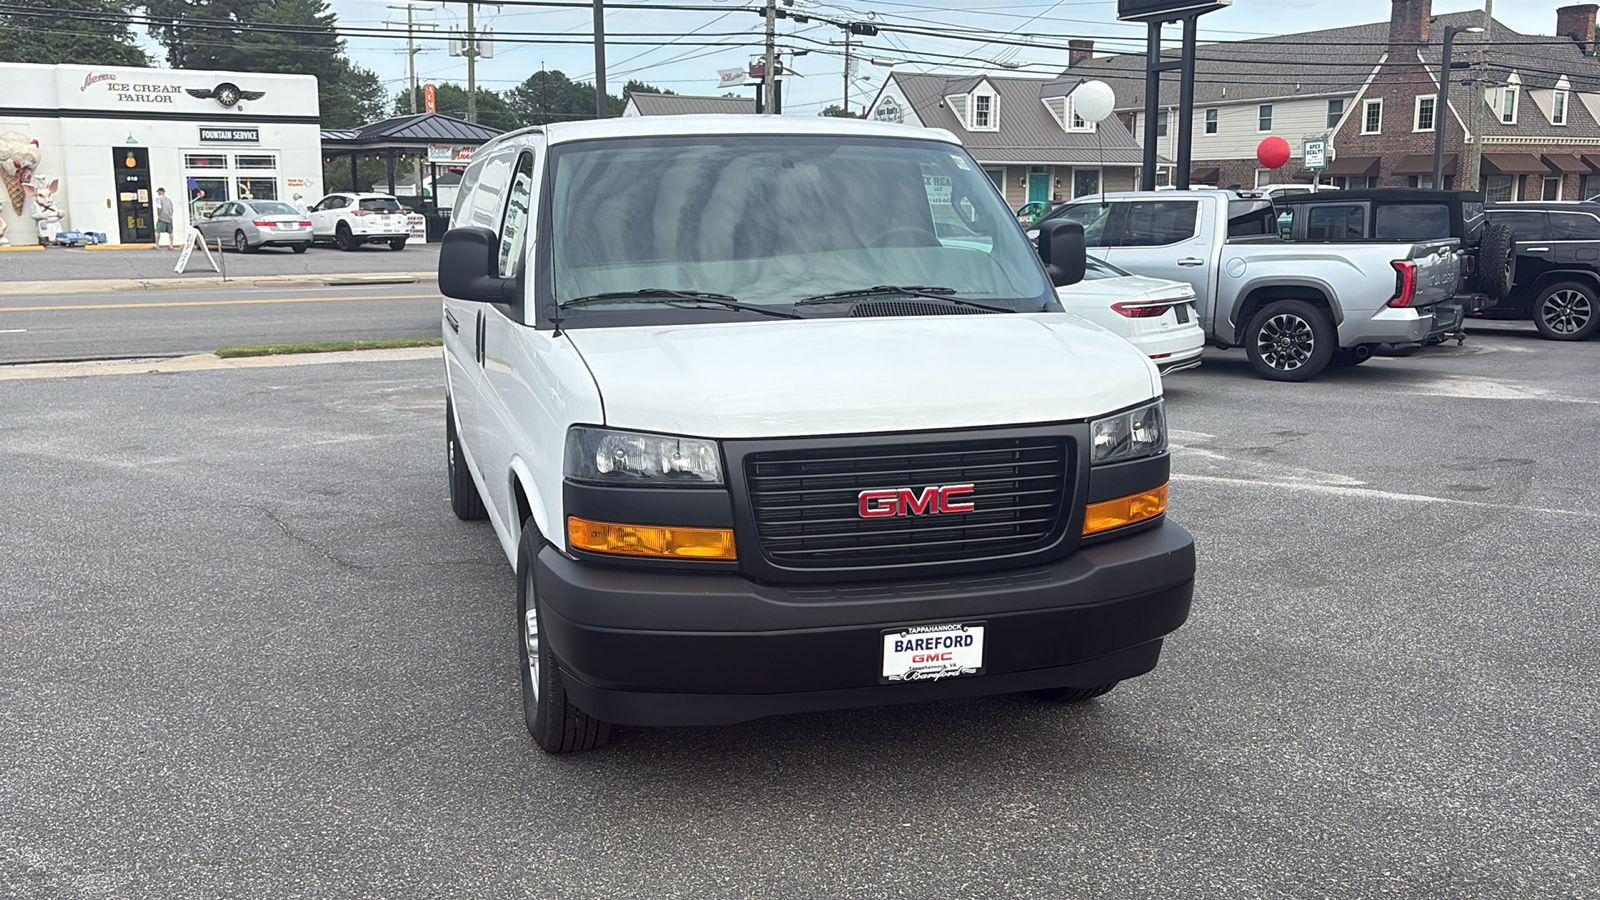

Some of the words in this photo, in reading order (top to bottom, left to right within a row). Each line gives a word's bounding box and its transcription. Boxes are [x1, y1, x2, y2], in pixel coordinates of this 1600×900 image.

[107, 82, 130, 92] ICE
[133, 83, 182, 94] CREAM
[117, 93, 173, 104] PARLOR
[201, 130, 232, 140] FOUNTAIN
[233, 131, 258, 140] SERVICE
[933, 177, 951, 186] REA
[858, 483, 975, 519] GMC
[907, 623, 963, 634] TAPPAHANNOCK
[894, 634, 974, 653] BAREFORD
[911, 652, 953, 664] GMC
[903, 665, 964, 682] Bareford
